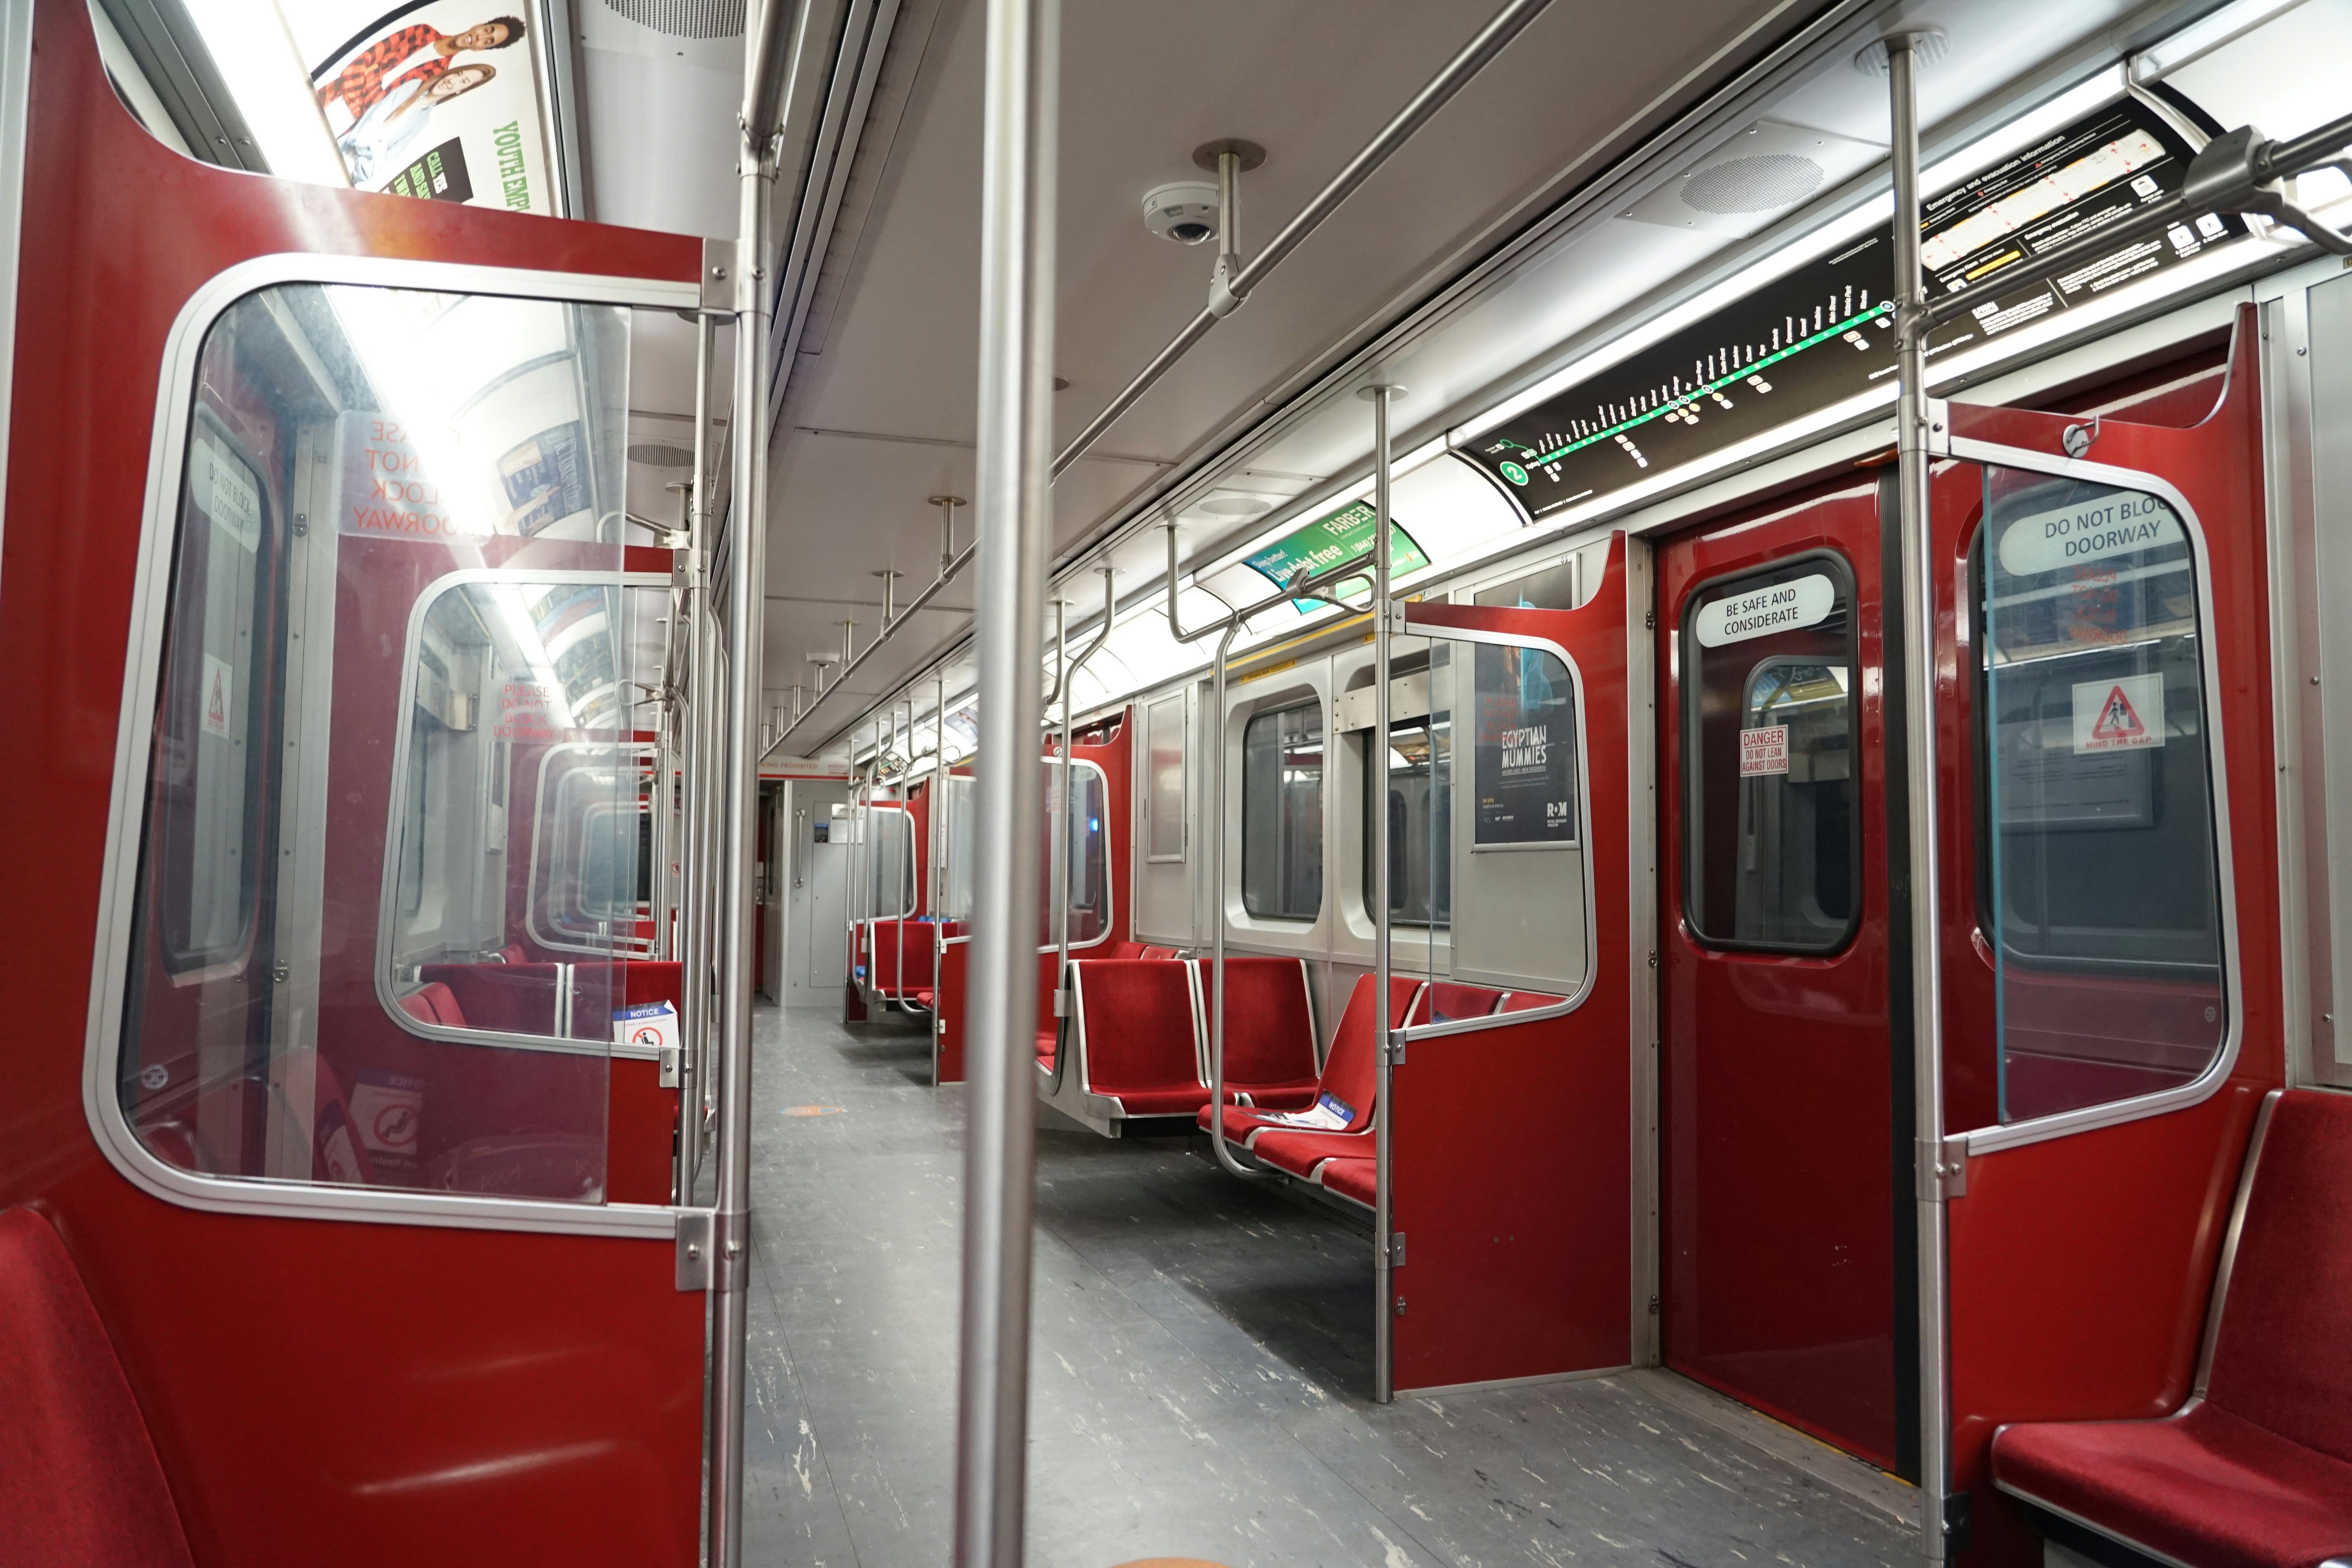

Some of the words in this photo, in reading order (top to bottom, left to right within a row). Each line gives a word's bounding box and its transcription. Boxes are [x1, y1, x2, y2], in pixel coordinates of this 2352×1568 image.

[493, 120, 525, 178] YOUTH
[410, 162, 425, 187] AND
[426, 151, 443, 178] CALL
[1926, 187, 1966, 211] Emergency
[1966, 178, 1982, 190] and
[1982, 160, 2021, 182] evacuation
[2020, 135, 2065, 162] information
[396, 178, 411, 198] WA
[416, 181, 431, 200] SAY
[433, 172, 448, 194] YES
[2024, 225, 2052, 240] Emergency
[2051, 211, 2079, 228] evacuation
[1939, 267, 1965, 283] Emergency
[1964, 261, 1978, 270] Alarm
[1507, 466, 1523, 480] 2
[209, 462, 218, 485] DO
[220, 472, 232, 498] NOT
[233, 485, 250, 516] BLOCK
[214, 495, 243, 534] DOORWAY
[1323, 505, 1376, 536] FARBER
[2045, 519, 2070, 539] DO
[2077, 507, 2114, 531] NOT
[2065, 520, 2161, 557] DOORWAY
[1267, 568, 1294, 583] Live
[1287, 557, 1320, 572] debt
[1309, 545, 1343, 565] free
[1727, 603, 1739, 617] BE
[1742, 595, 1767, 613] SAFE
[1771, 589, 1796, 606] AND
[1725, 606, 1798, 635] CONSIDERATE
[505, 684, 550, 697] PLEASE
[502, 698, 520, 710] DO
[525, 699, 552, 710] NOT
[505, 712, 546, 725] BLOCK
[494, 726, 554, 739] DOORWAY
[1502, 725, 1546, 750] EGYPTIAN
[1744, 730, 1783, 746] DANGER
[2085, 740, 2108, 749] MIND
[2111, 737, 2129, 746] THE
[2131, 736, 2152, 744] GAP
[1502, 745, 1547, 768] MUMMIES
[1746, 750, 1753, 760] DO
[1755, 748, 1766, 758] NOT
[1768, 747, 1782, 757] LEAN
[1742, 760, 1765, 772] AGAINST
[1767, 758, 1786, 770] DOORS
[630, 1008, 659, 1018] NOTICE
[1328, 1102, 1345, 1116] NOTICE
